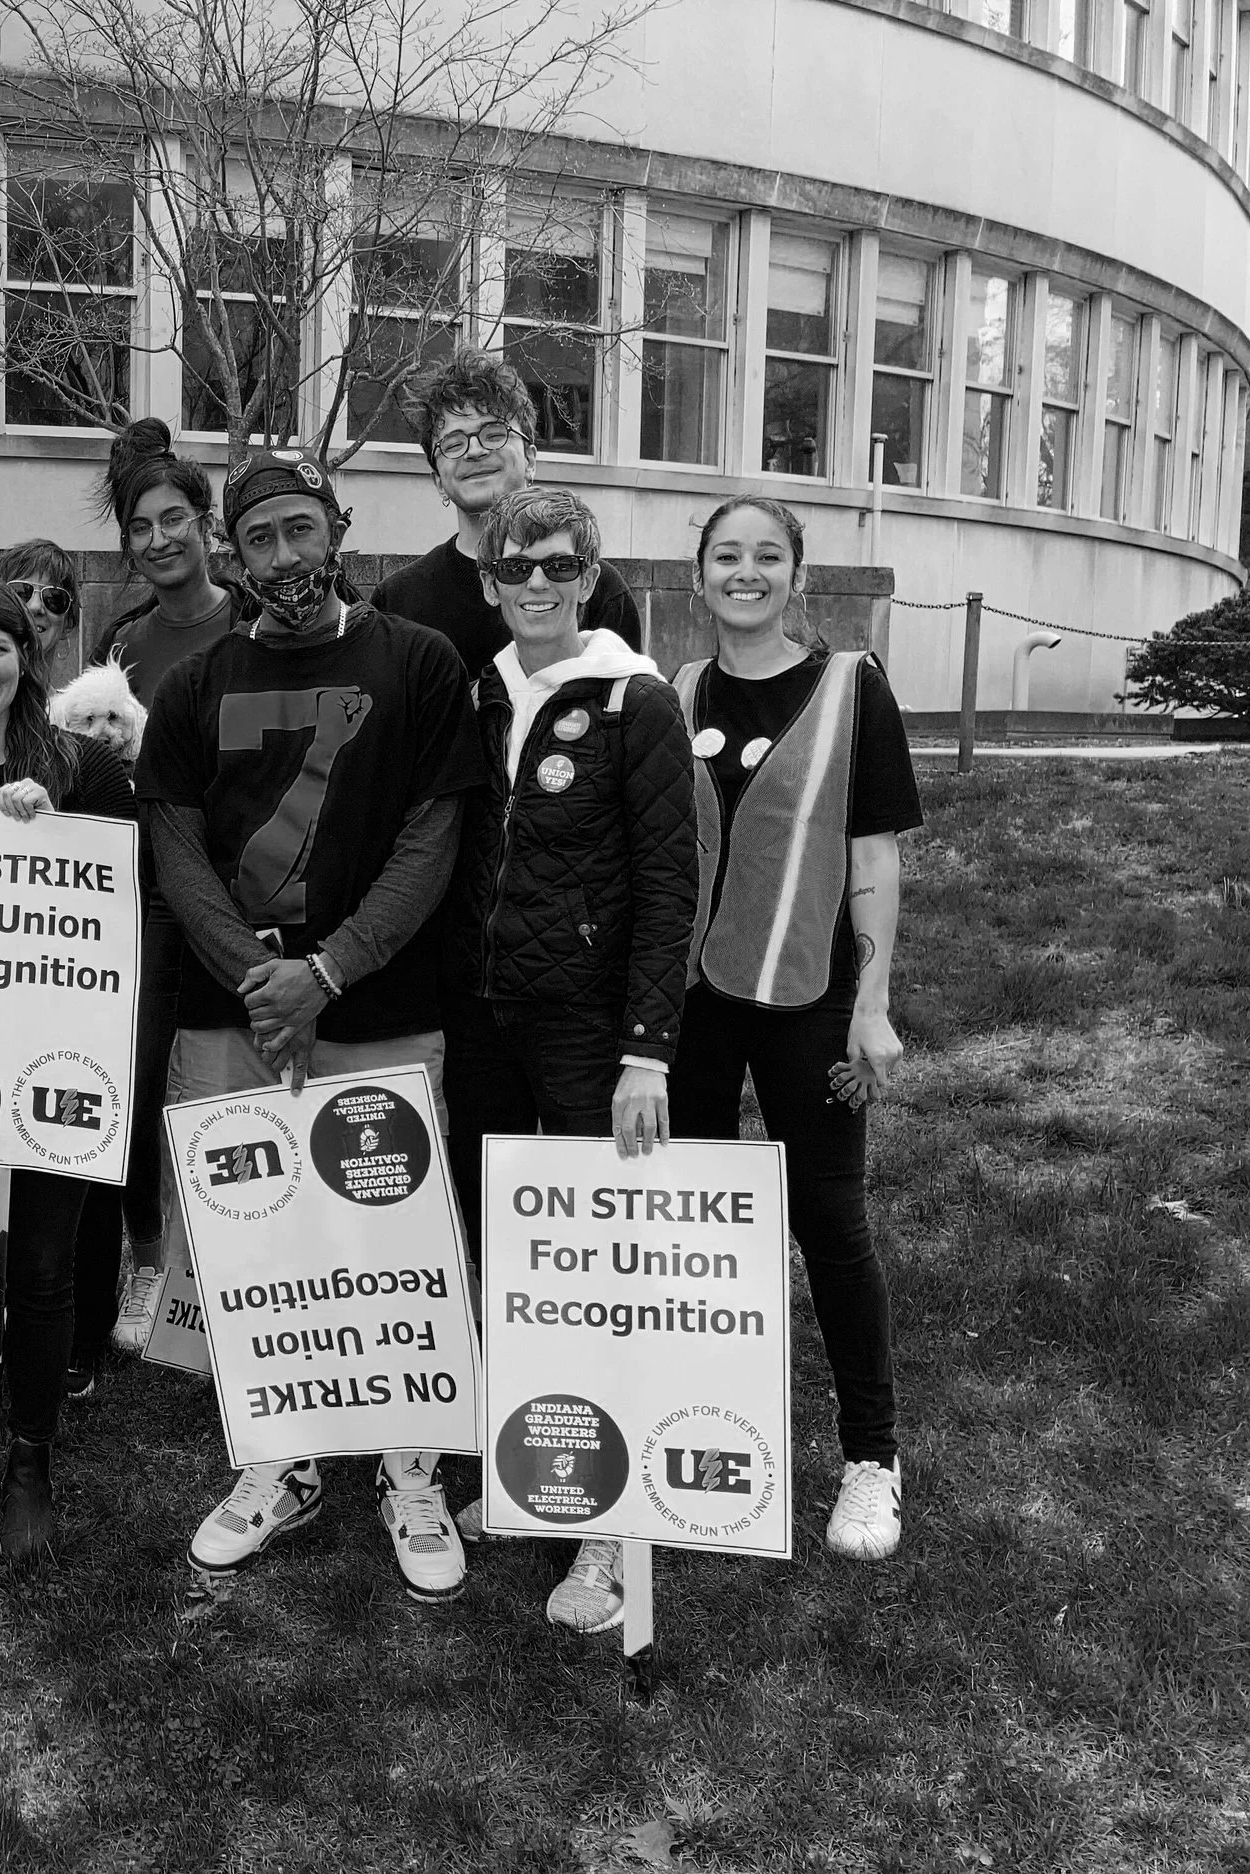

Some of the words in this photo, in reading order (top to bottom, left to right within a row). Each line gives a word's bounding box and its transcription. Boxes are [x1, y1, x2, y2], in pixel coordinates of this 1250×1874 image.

[541, 767, 574, 780] UNION
[545, 776, 566, 786] YES!
[12, 1076, 27, 1098] THE
[22, 1052, 56, 1076] UNION
[58, 1050, 81, 1062] FOR
[82, 1056, 121, 1110] EVERYONE
[32, 1086, 102, 1130] UE
[225, 1104, 250, 1116] RUN
[332, 1100, 396, 1116] ELECTRICAL
[337, 1093, 388, 1106] WORKERS
[199, 1110, 224, 1131] THIS
[254, 1106, 300, 1150] MEMBERS
[346, 1111, 386, 1124] UNITED
[11, 1108, 47, 1157] MEMBERS
[48, 1152, 71, 1166] RUN
[74, 1149, 98, 1166] THIS
[96, 1120, 120, 1152] UNION
[186, 1130, 204, 1166] UNION
[204, 1140, 285, 1186] UE
[291, 1160, 302, 1184] THE
[340, 1153, 408, 1169] COALITION
[345, 1164, 407, 1179] WORKERS
[344, 1174, 412, 1190] GRADUATE
[352, 1185, 409, 1200] INDIANA
[190, 1176, 240, 1220] EVERYONE
[268, 1184, 298, 1214] UNION
[512, 1185, 576, 1218] ON
[590, 1187, 754, 1225] STRIKE
[243, 1208, 268, 1221] FOR
[529, 1239, 598, 1272] For
[612, 1242, 738, 1280] Union
[220, 1267, 448, 1314] Recognition
[166, 1298, 206, 1334] IKE
[505, 1292, 764, 1337] Recognition
[251, 1326, 364, 1360] Union
[375, 1320, 437, 1352] For
[246, 1374, 392, 1419] STRIKE
[404, 1371, 458, 1404] ON
[524, 1414, 600, 1428] GRADUATE
[530, 1402, 594, 1416] INDIANA
[523, 1436, 601, 1450] COALITION
[528, 1425, 597, 1438] WORKERS
[641, 1435, 658, 1462] THE
[652, 1407, 690, 1437] UNION
[692, 1405, 720, 1418] FOR
[723, 1410, 776, 1470] EVERYONE
[664, 1448, 752, 1494] UE
[527, 1494, 598, 1506] ELECTRICAL
[540, 1485, 585, 1496] UNITED
[534, 1504, 592, 1516] WORKERS
[641, 1472, 687, 1530] MEMBERS
[690, 1523, 718, 1537] RUN
[720, 1516, 752, 1536] THIS
[749, 1480, 775, 1520] UNION
